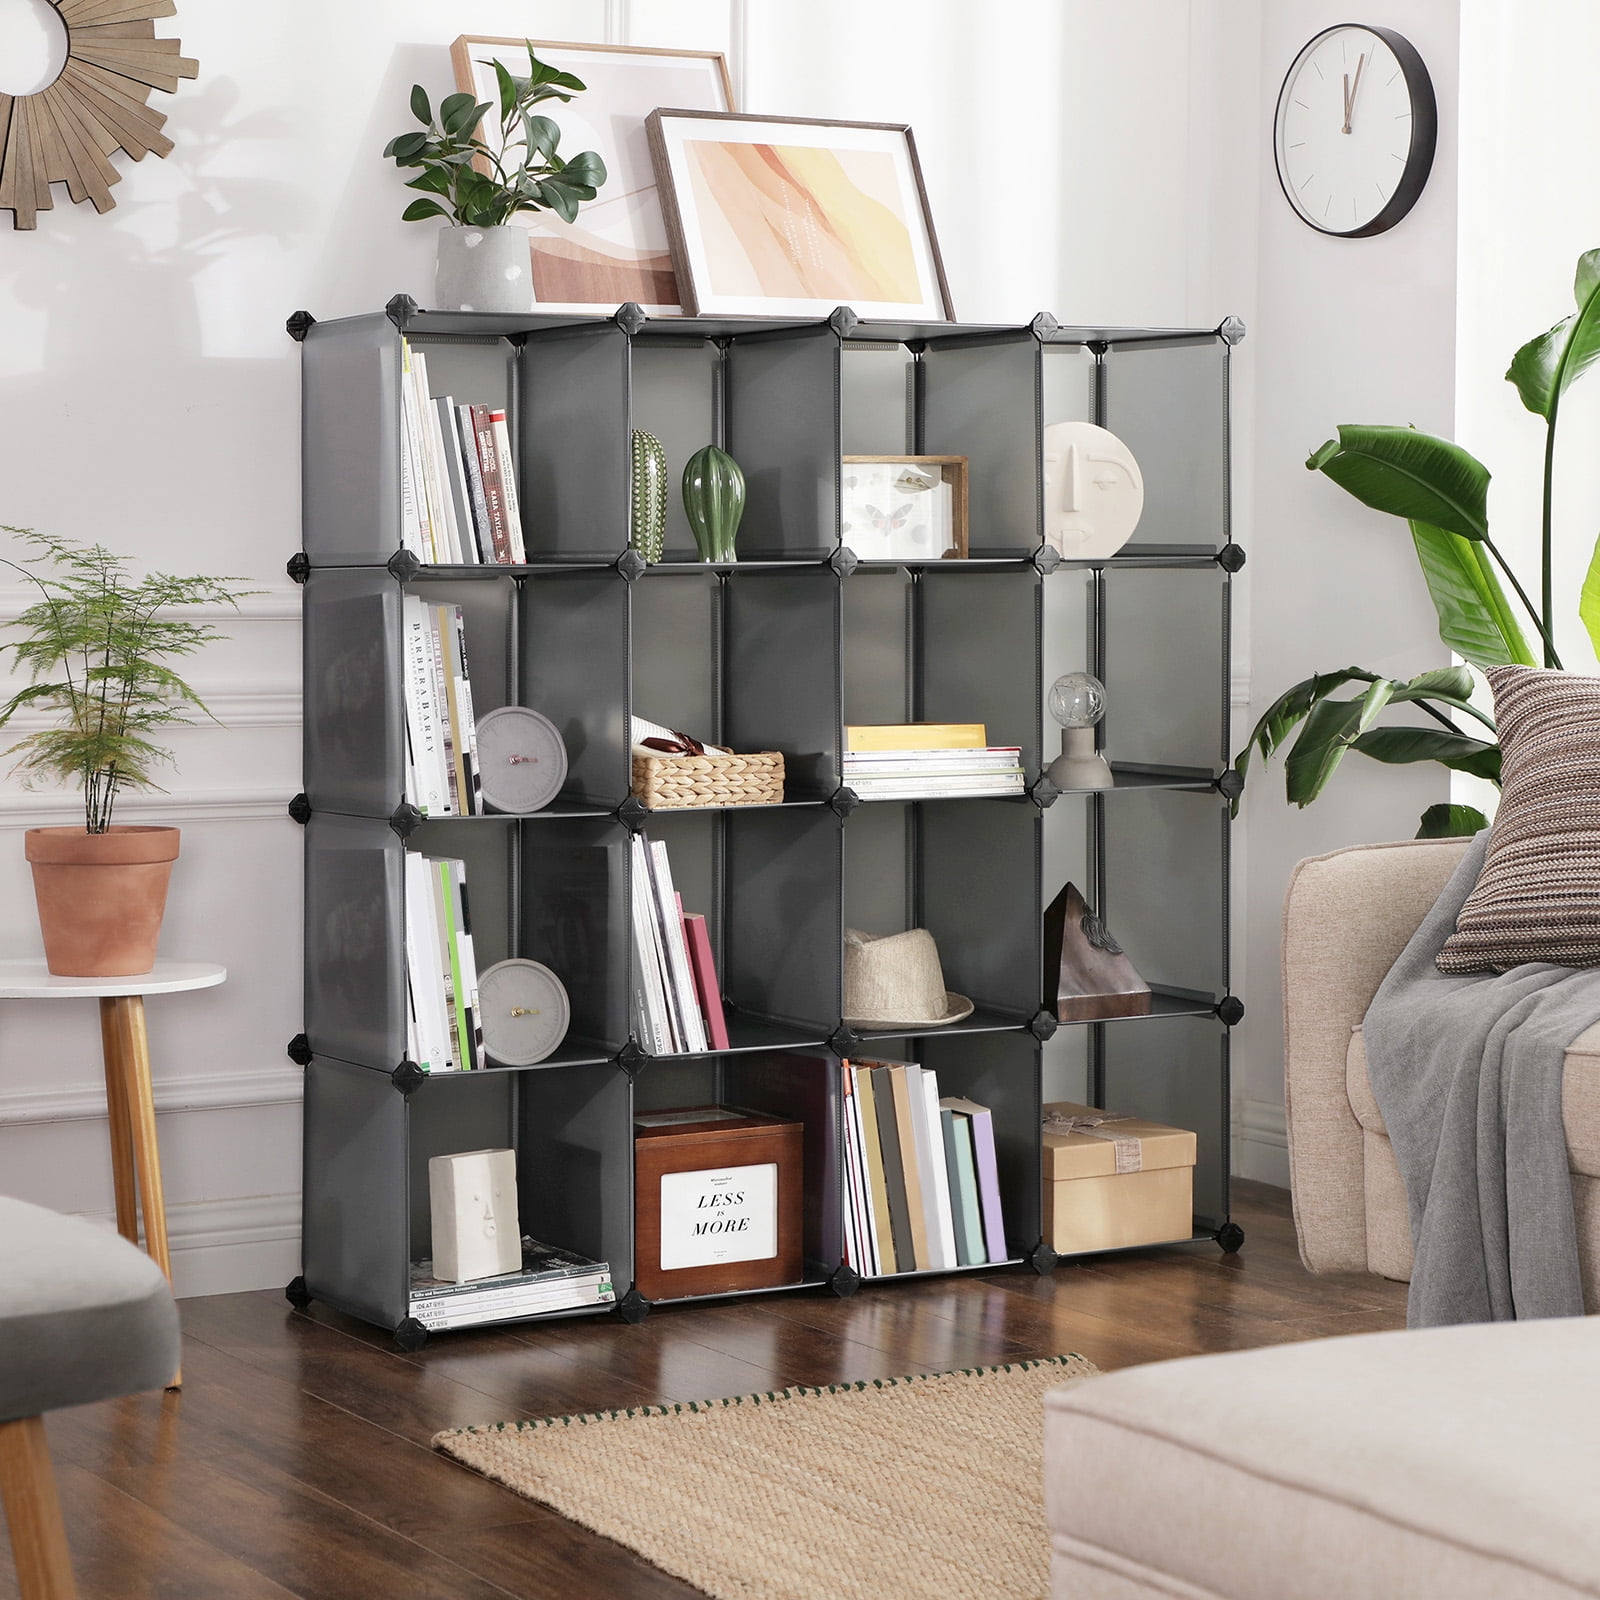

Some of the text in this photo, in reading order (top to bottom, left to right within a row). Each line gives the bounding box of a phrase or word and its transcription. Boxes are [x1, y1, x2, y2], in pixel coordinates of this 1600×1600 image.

[494, 511, 502, 539] TAYLOR
[413, 623, 427, 696] BARBERA
[422, 701, 434, 753] BAREY
[432, 630, 451, 739] FURNITURE DESIGN
[698, 1191, 745, 1209] LESS
[691, 1217, 750, 1237] MORE
